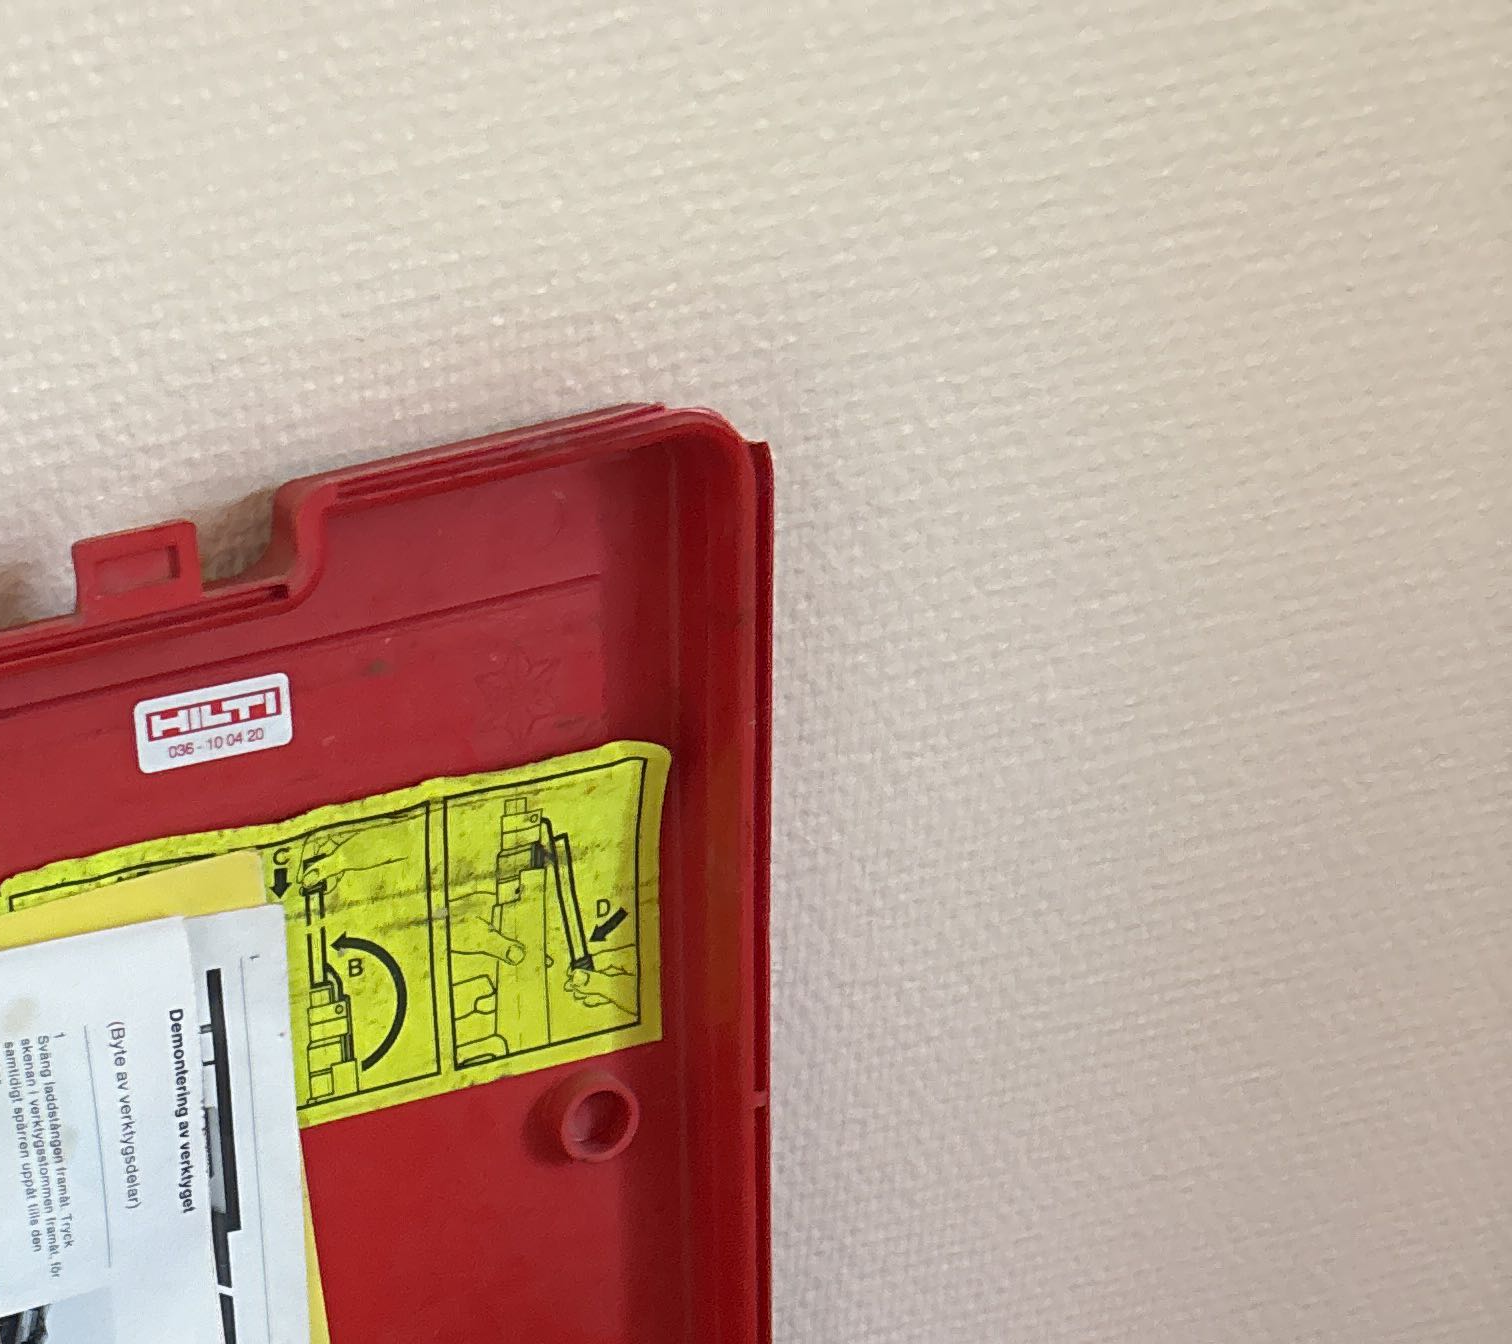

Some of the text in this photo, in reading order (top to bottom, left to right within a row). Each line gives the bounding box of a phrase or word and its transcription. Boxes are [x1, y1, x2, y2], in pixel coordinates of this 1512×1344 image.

[151, 691, 277, 738] HILTI
[168, 742, 194, 758] 036
[207, 736, 223, 750] 10
[226, 732, 242, 746] 04
[248, 728, 264, 742] 20
[273, 847, 289, 866] C
[596, 899, 612, 918] D
[348, 958, 363, 977] B
[21, 1038, 36, 1087] skenan
[107, 1021, 142, 1209] (Byte av verktygsdelar)
[169, 1008, 194, 1213] Demontering av verktyget
[30, 1229, 45, 1252] den
[60, 1214, 73, 1248] Tryck
